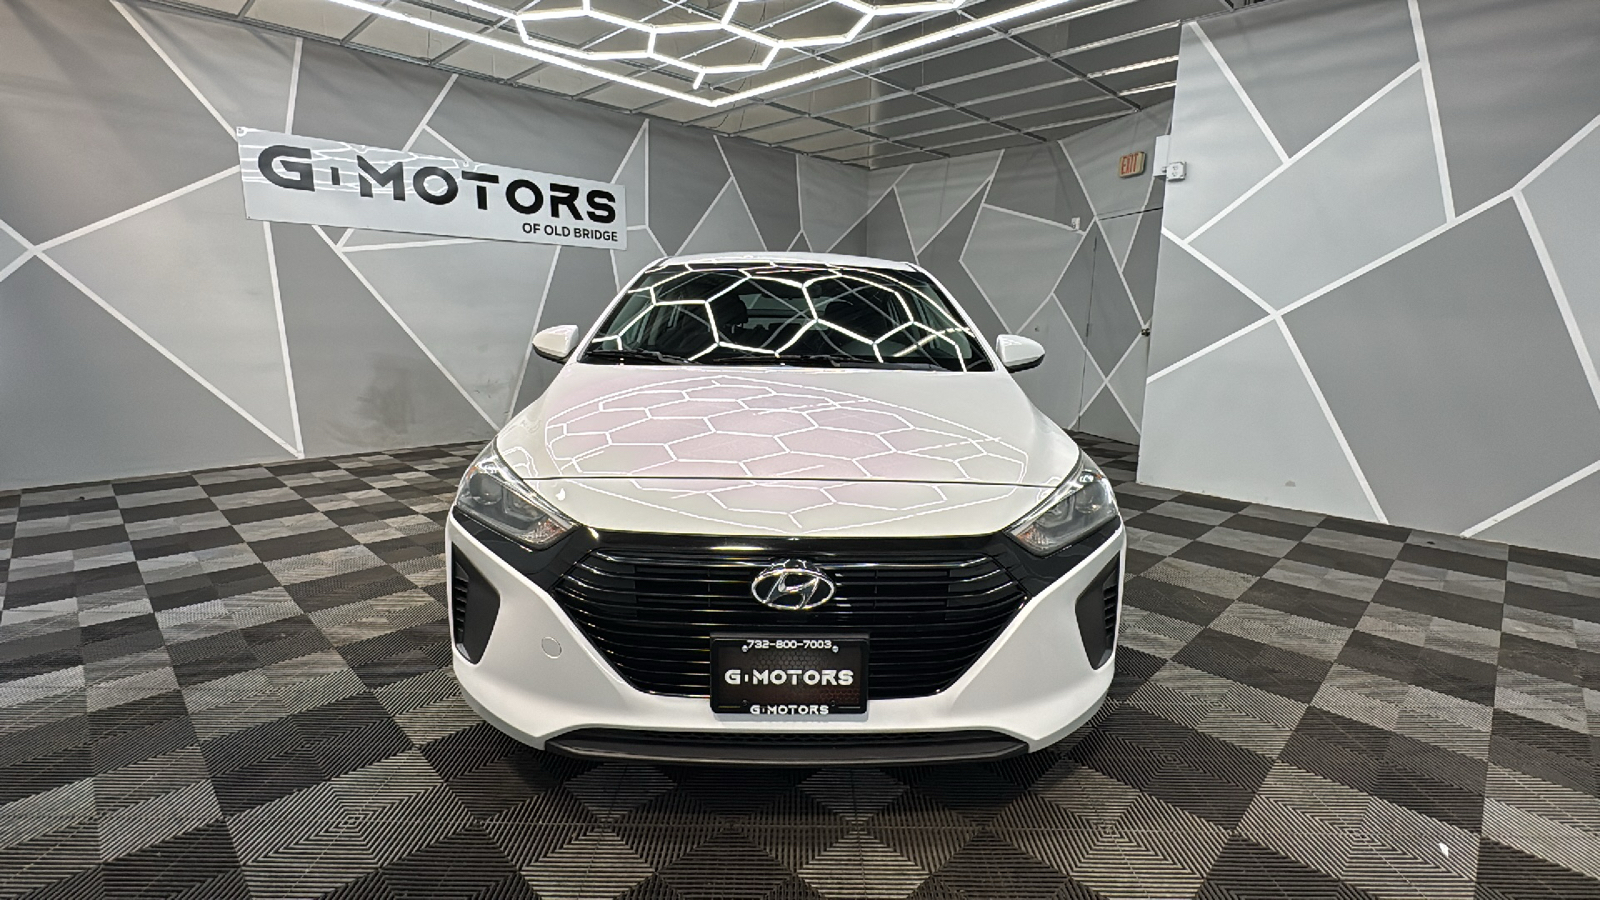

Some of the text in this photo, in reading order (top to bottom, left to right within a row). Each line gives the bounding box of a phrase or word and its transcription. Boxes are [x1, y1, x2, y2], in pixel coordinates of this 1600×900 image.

[1120, 152, 1139, 175] EXIT
[522, 222, 618, 242] OF OLD BRIDGE
[747, 640, 832, 649] 732-800-7003
